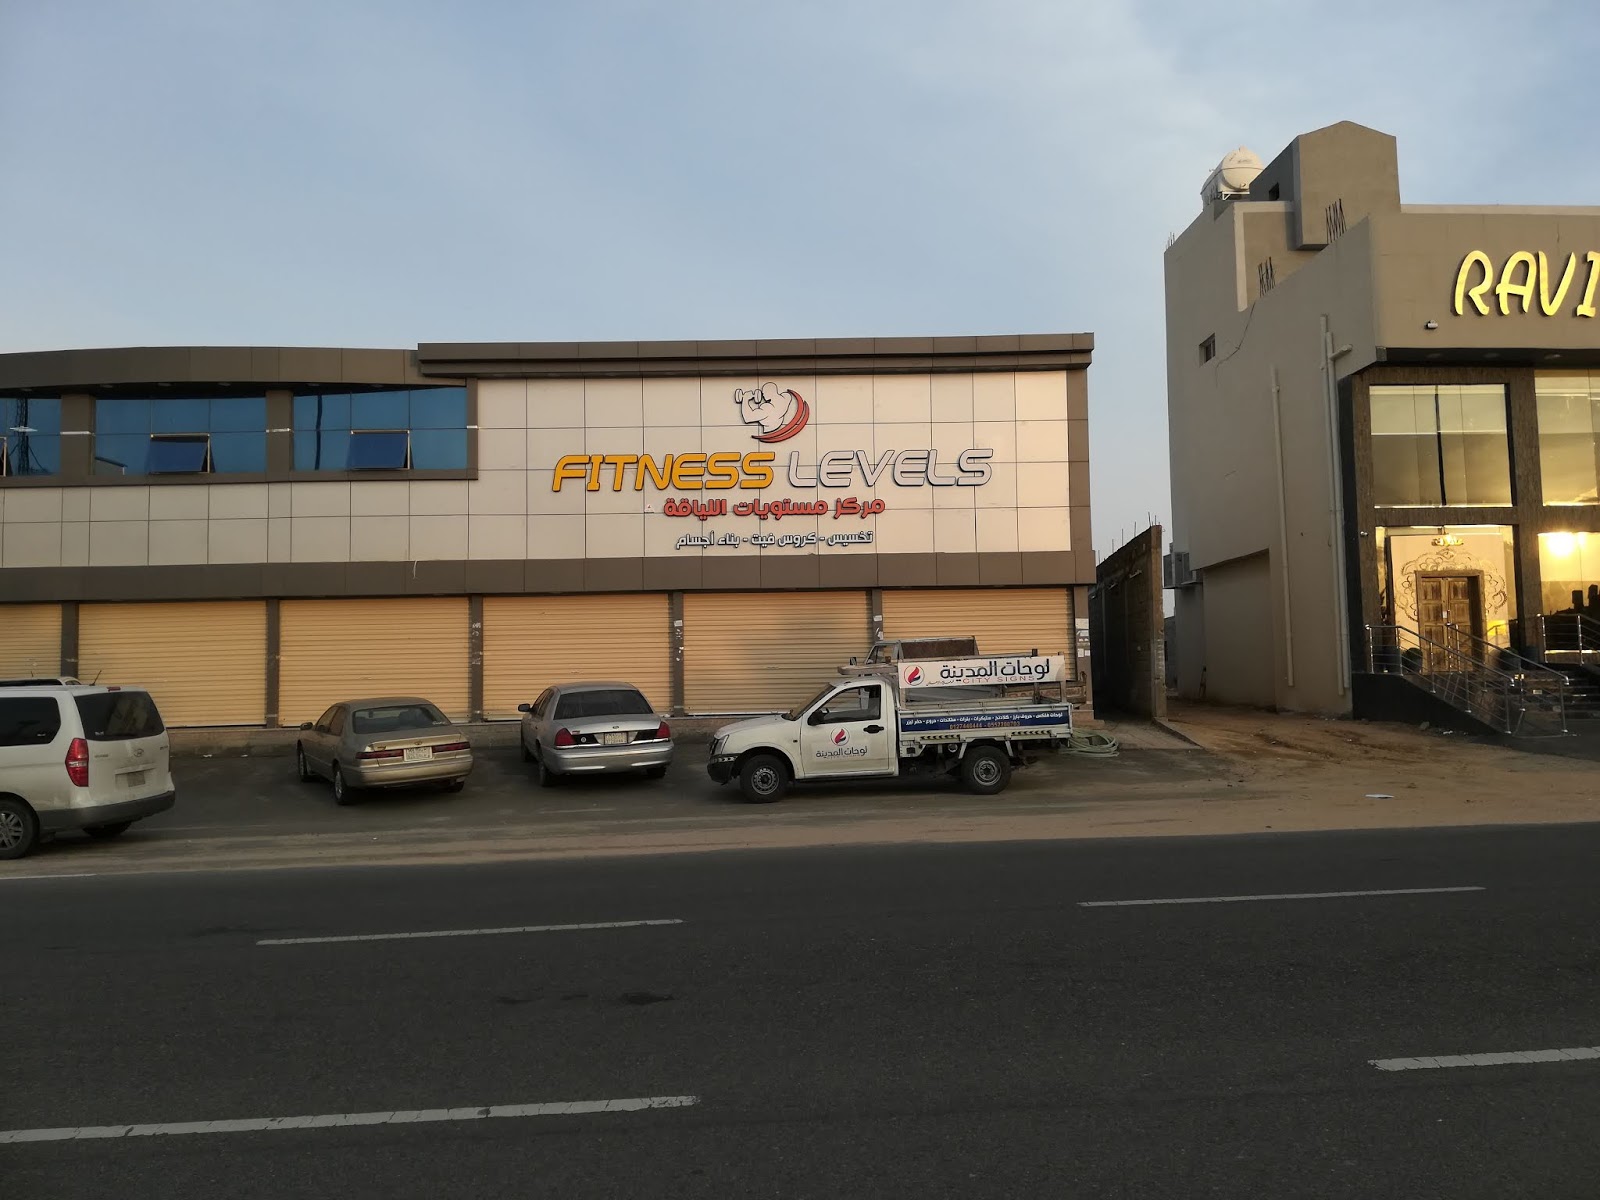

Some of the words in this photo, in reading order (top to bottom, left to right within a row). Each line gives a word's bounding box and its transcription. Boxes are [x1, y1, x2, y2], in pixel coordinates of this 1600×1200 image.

[1454, 250, 1600, 317] RAVI
[552, 452, 776, 492] FITNESS
[788, 448, 994, 488] LEVELS
[663, 497, 728, 521] اللياقة
[733, 497, 829, 521] مستويات
[833, 496, 886, 520] مركز
[675, 529, 715, 550] أجسام
[717, 532, 741, 549] بناء
[751, 532, 776, 548] فيت
[778, 531, 818, 548] كروس
[827, 530, 874, 547] تخسيس
[939, 660, 998, 682] المدينة
[962, 676, 991, 685] CITY
[996, 675, 1036, 683] SIGNS
[1000, 658, 1050, 681] لوحات
[815, 747, 844, 759] المدينة
[844, 745, 868, 757] لوحات
